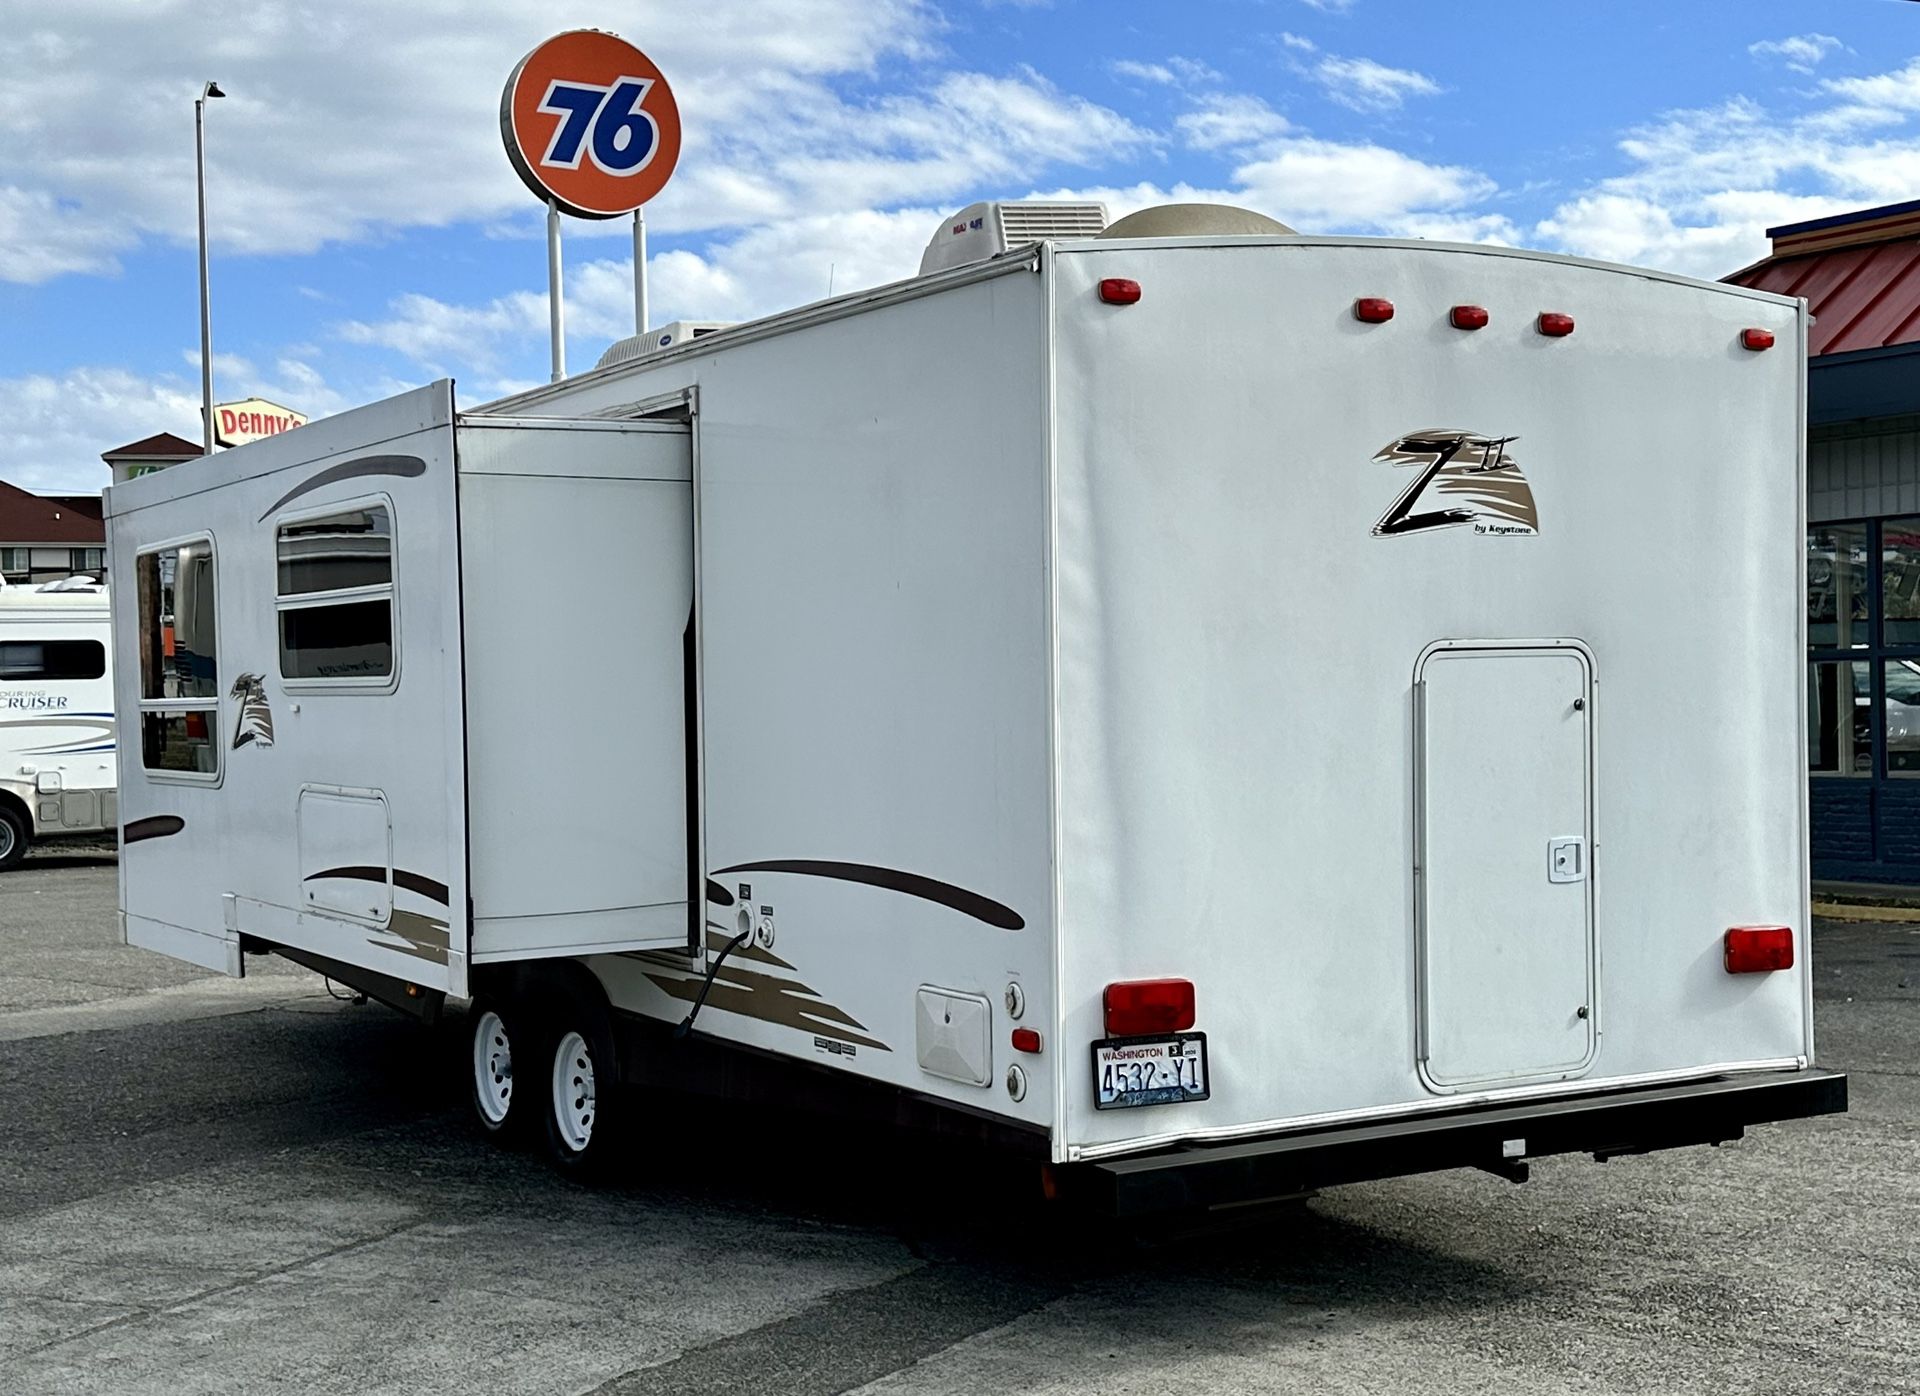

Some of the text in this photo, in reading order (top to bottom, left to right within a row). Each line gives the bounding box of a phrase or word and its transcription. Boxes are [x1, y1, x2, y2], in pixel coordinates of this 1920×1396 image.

[537, 75, 656, 177] 76
[1474, 524, 1532, 535] by Keystone
[0, 696, 68, 708] CRUISER
[1102, 1047, 1163, 1061] WASHINGTON
